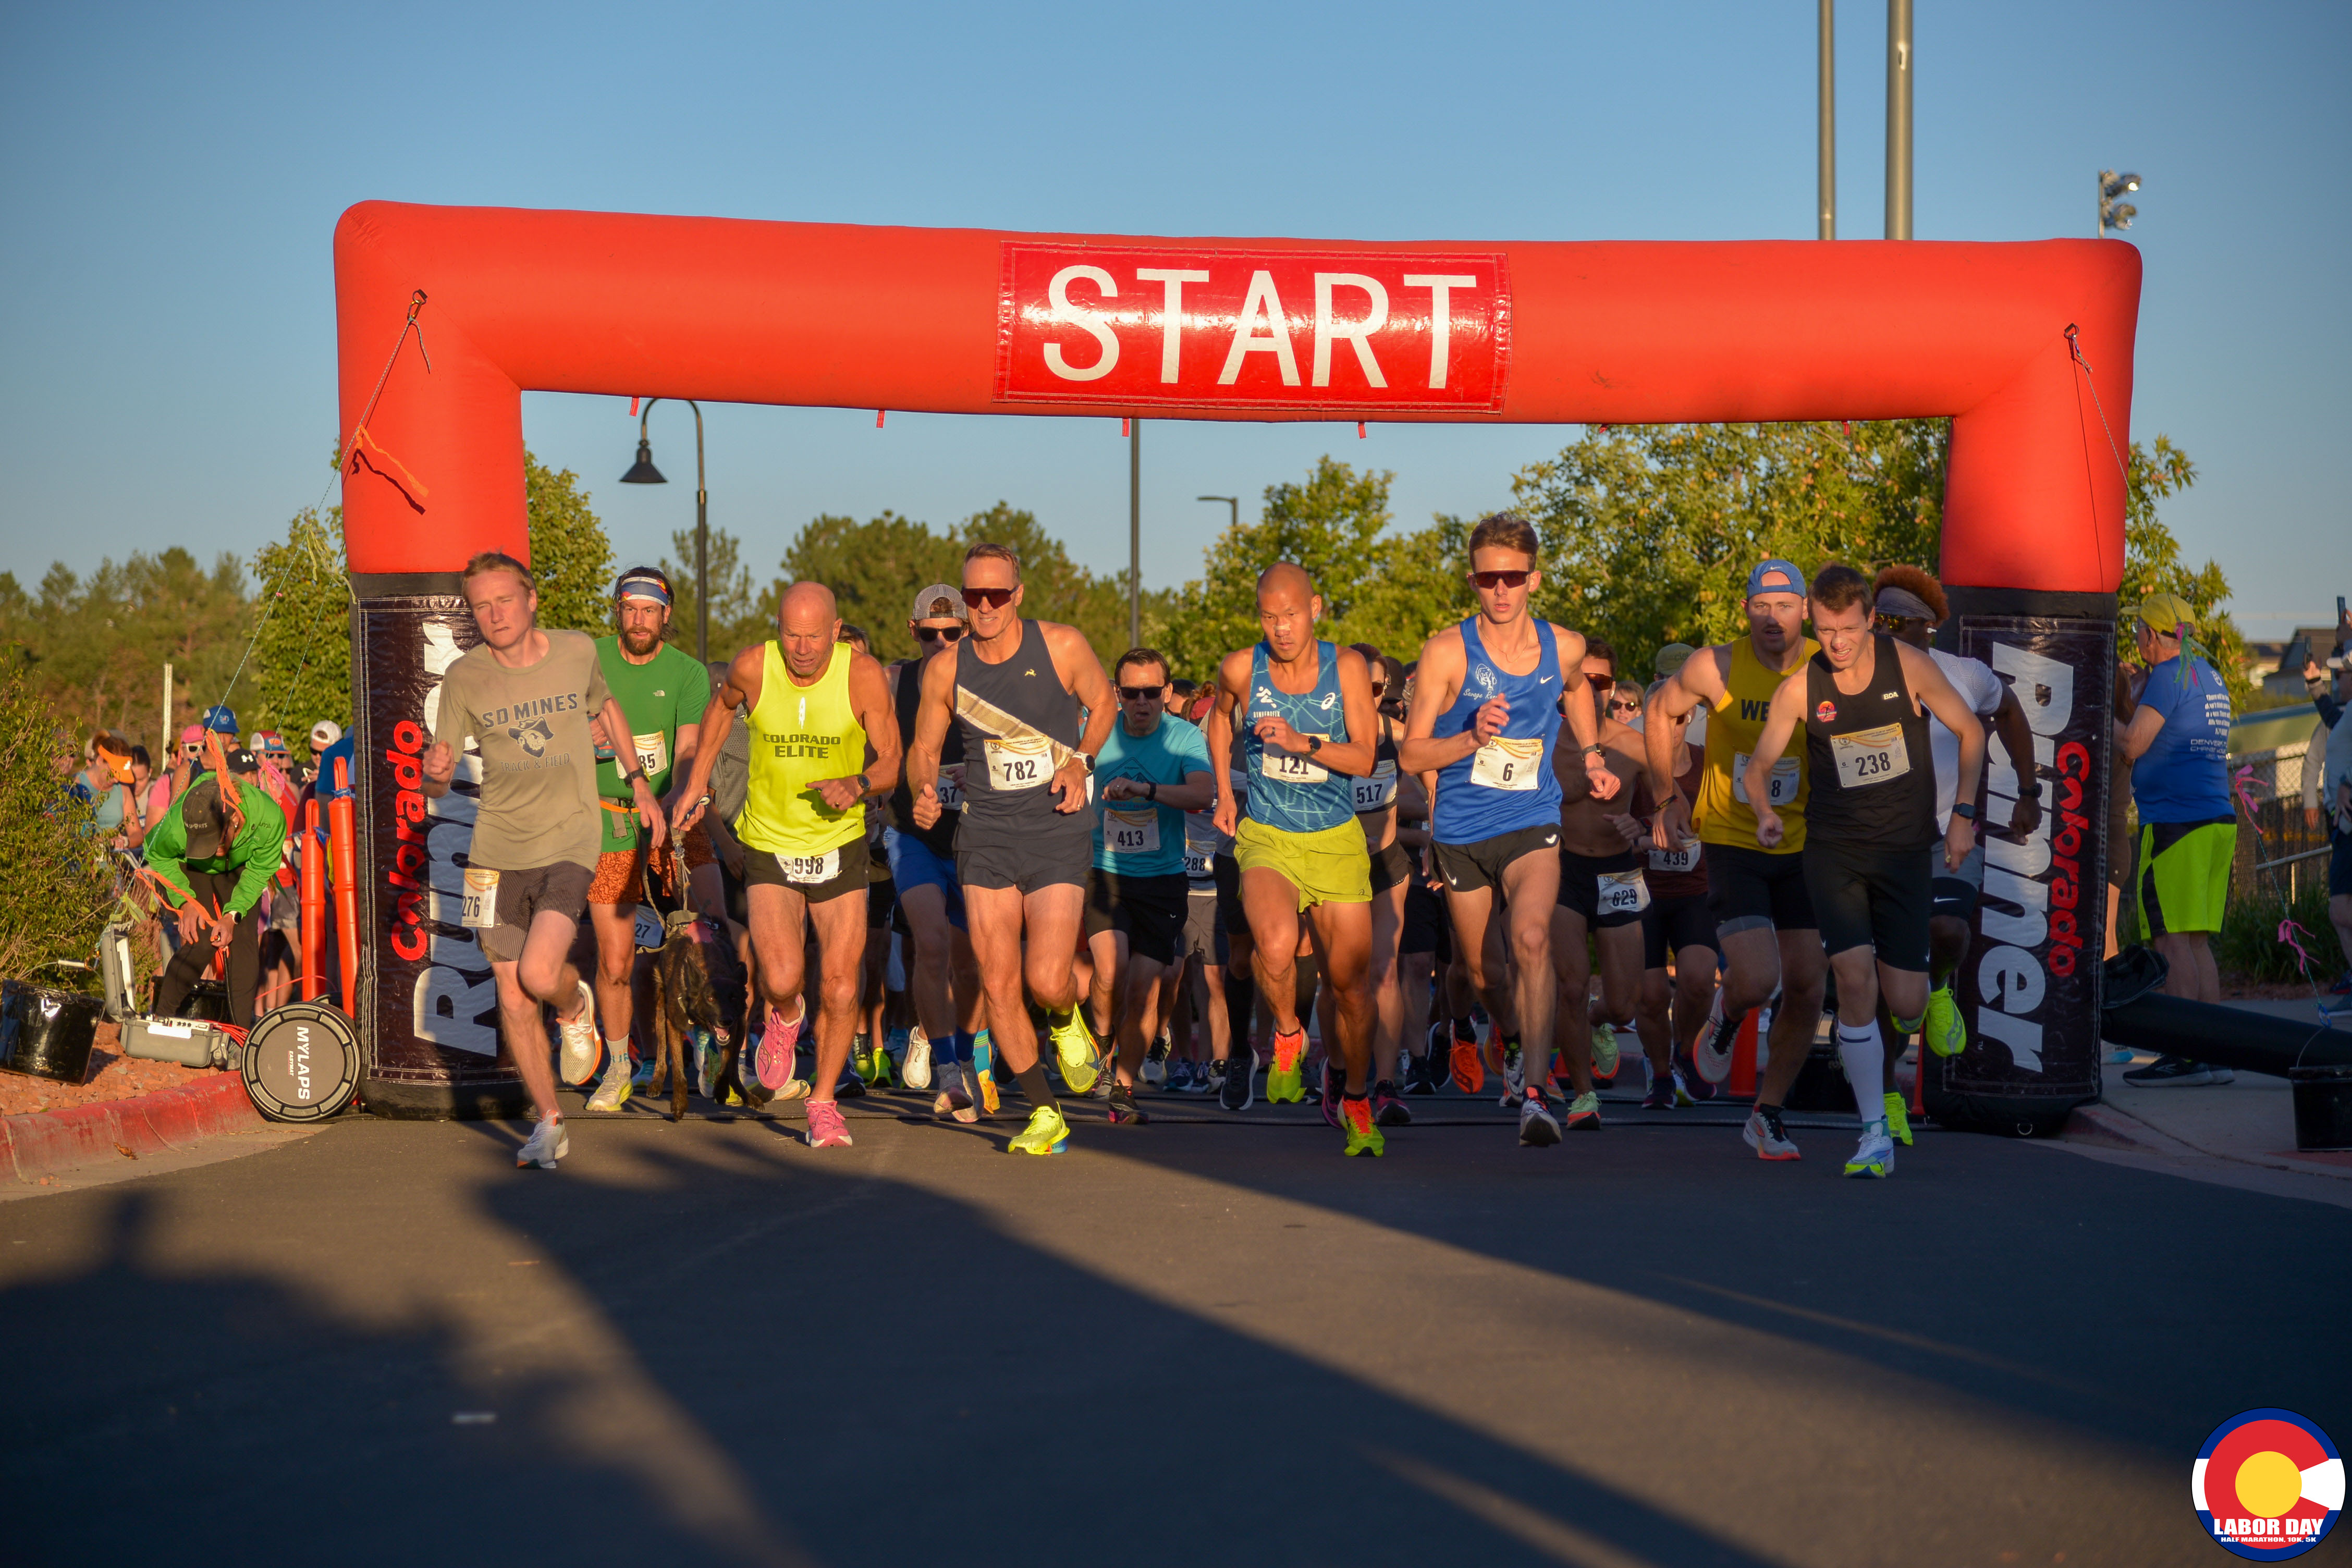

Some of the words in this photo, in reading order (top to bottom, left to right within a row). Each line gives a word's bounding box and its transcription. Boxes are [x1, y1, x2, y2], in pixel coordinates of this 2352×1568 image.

[1044, 265, 1476, 388] START
[1463, 688, 1483, 700] Savage
[1883, 691, 1899, 700] BOA
[482, 707, 509, 728] SD
[513, 693, 578, 720] MINES
[1741, 699, 1771, 721] WE
[763, 733, 841, 745] COLORADO
[638, 753, 656, 769] 85
[775, 745, 829, 758] ELITE
[501, 760, 530, 773] TRACK
[534, 759, 541, 769] &
[545, 753, 570, 768] FIELD
[1003, 760, 1037, 782] 782
[1279, 755, 1309, 775] 121
[1502, 763, 1514, 781] 6
[1855, 752, 1891, 777] 238
[939, 786, 958, 804] 37
[1356, 783, 1383, 804] 517
[386, 720, 428, 961] Colorado
[1117, 830, 1144, 847] 413
[794, 857, 824, 875] 998
[1184, 856, 1206, 872] 288
[1663, 851, 1689, 866] 439
[2048, 741, 2090, 978] Colorado
[462, 896, 481, 918] 276
[1612, 888, 1638, 907] 629
[635, 923, 651, 939] 27
[297, 1026, 310, 1100] MYLAPS
